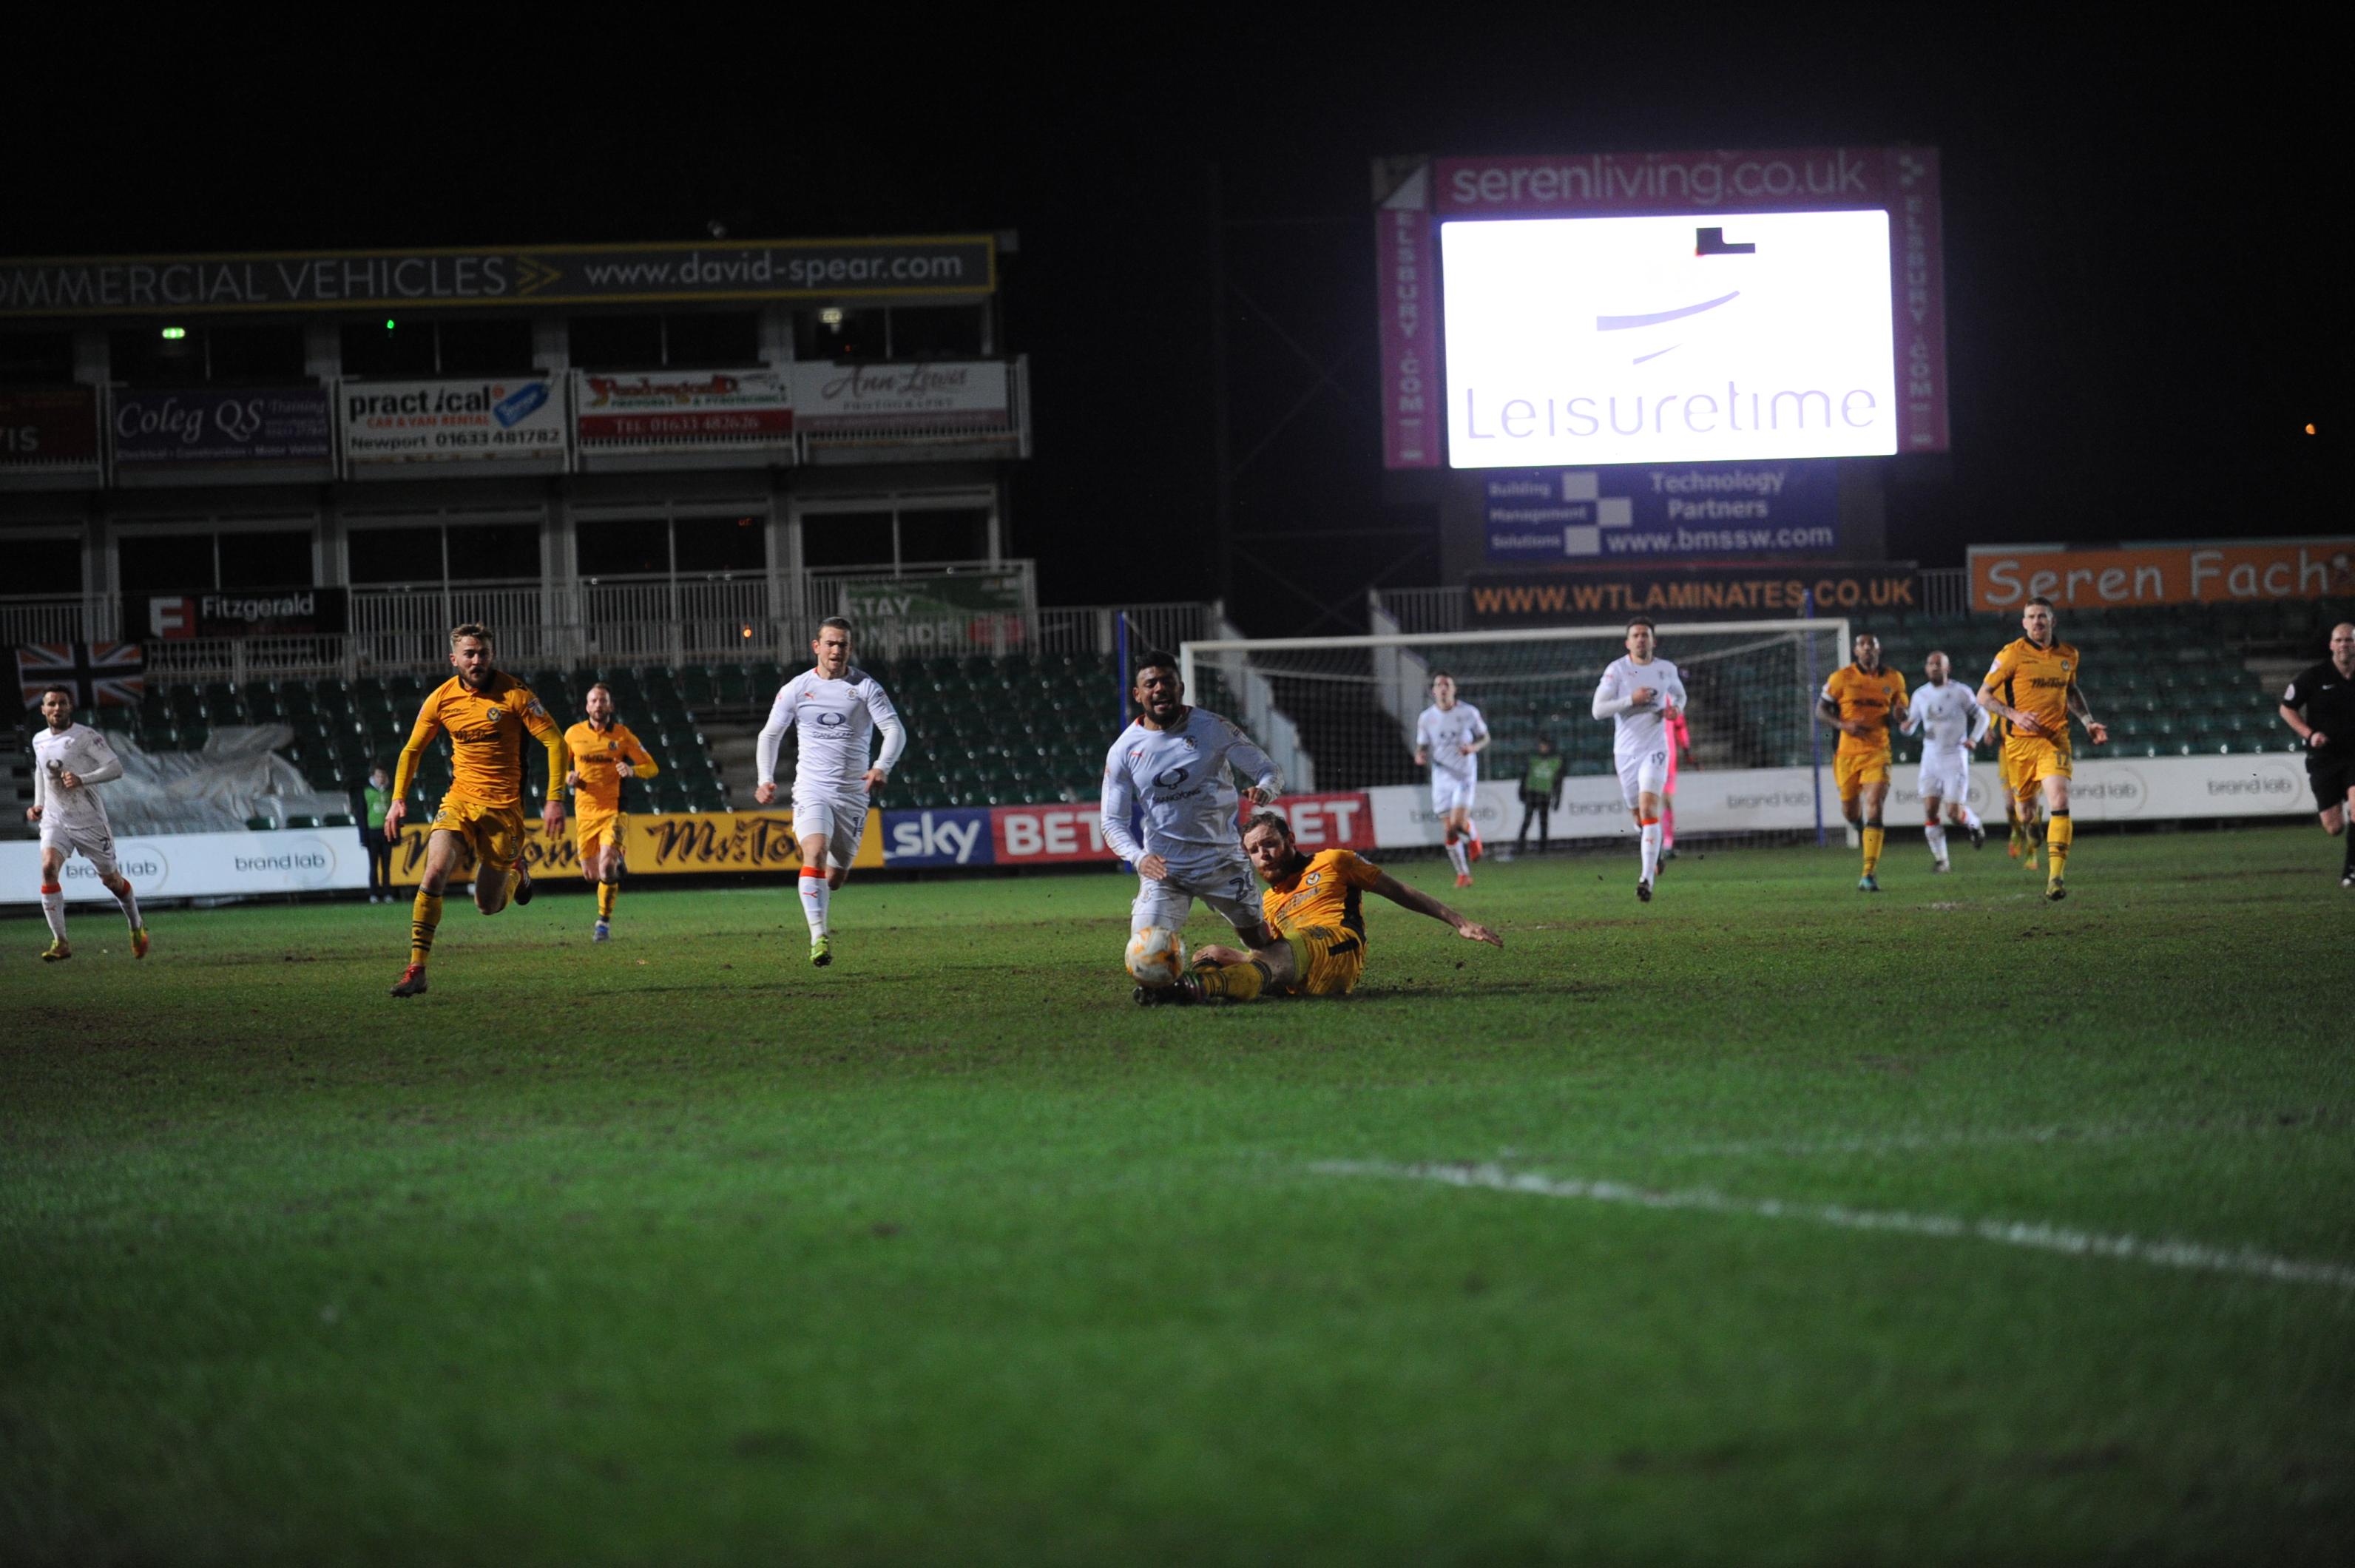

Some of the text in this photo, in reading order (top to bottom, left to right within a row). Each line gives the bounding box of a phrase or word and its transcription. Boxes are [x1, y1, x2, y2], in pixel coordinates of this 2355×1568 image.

[1451, 149, 1867, 205] serenliving.co.uk
[0, 249, 963, 305] MMERCIAL VEHICLES www.david-spear.com
[117, 397, 203, 443] Coleg
[215, 399, 264, 442] QS
[0, 425, 39, 453] IS
[351, 436, 427, 450] Newport
[1650, 470, 1785, 494] Technology
[1669, 497, 1768, 521] Partners
[1606, 526, 1833, 553] www.bmssw.com
[1985, 548, 2328, 605] Seren Fach
[202, 591, 314, 622] Fitzgerald
[1473, 578, 1913, 613] WWW.WTLAMINATESCO.UK
[1652, 751, 1665, 766] 19
[892, 811, 981, 864] sky
[1004, 812, 1104, 855] BET
[234, 853, 325, 872] brand lab
